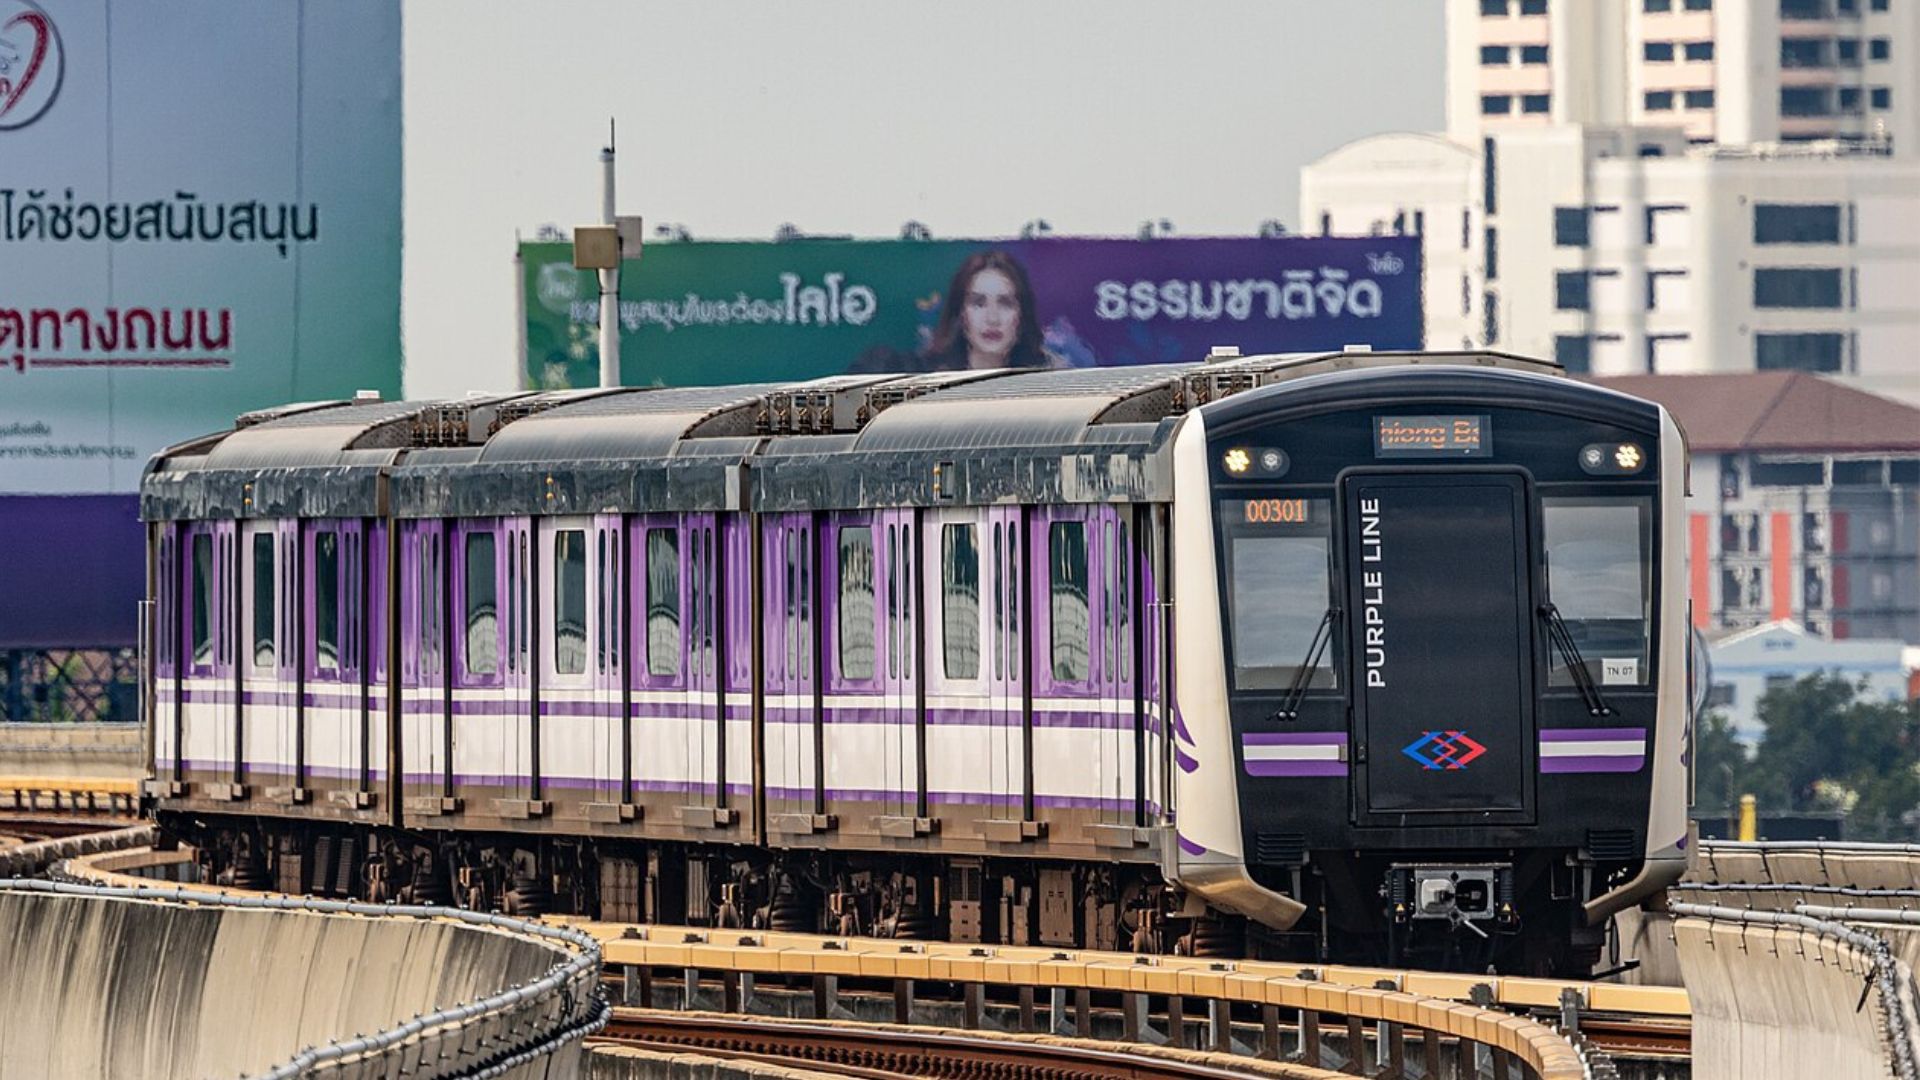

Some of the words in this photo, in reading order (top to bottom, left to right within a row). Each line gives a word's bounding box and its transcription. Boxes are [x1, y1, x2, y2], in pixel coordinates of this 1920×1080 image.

[0, 187, 318, 258] ได้ช่วยสนับสนุน
[1247, 499, 1304, 523] 00301
[1361, 498, 1381, 561] LINE
[1364, 572, 1386, 687] PURPLE
[1607, 666, 1619, 676] TN
[1622, 666, 1633, 676] 07
